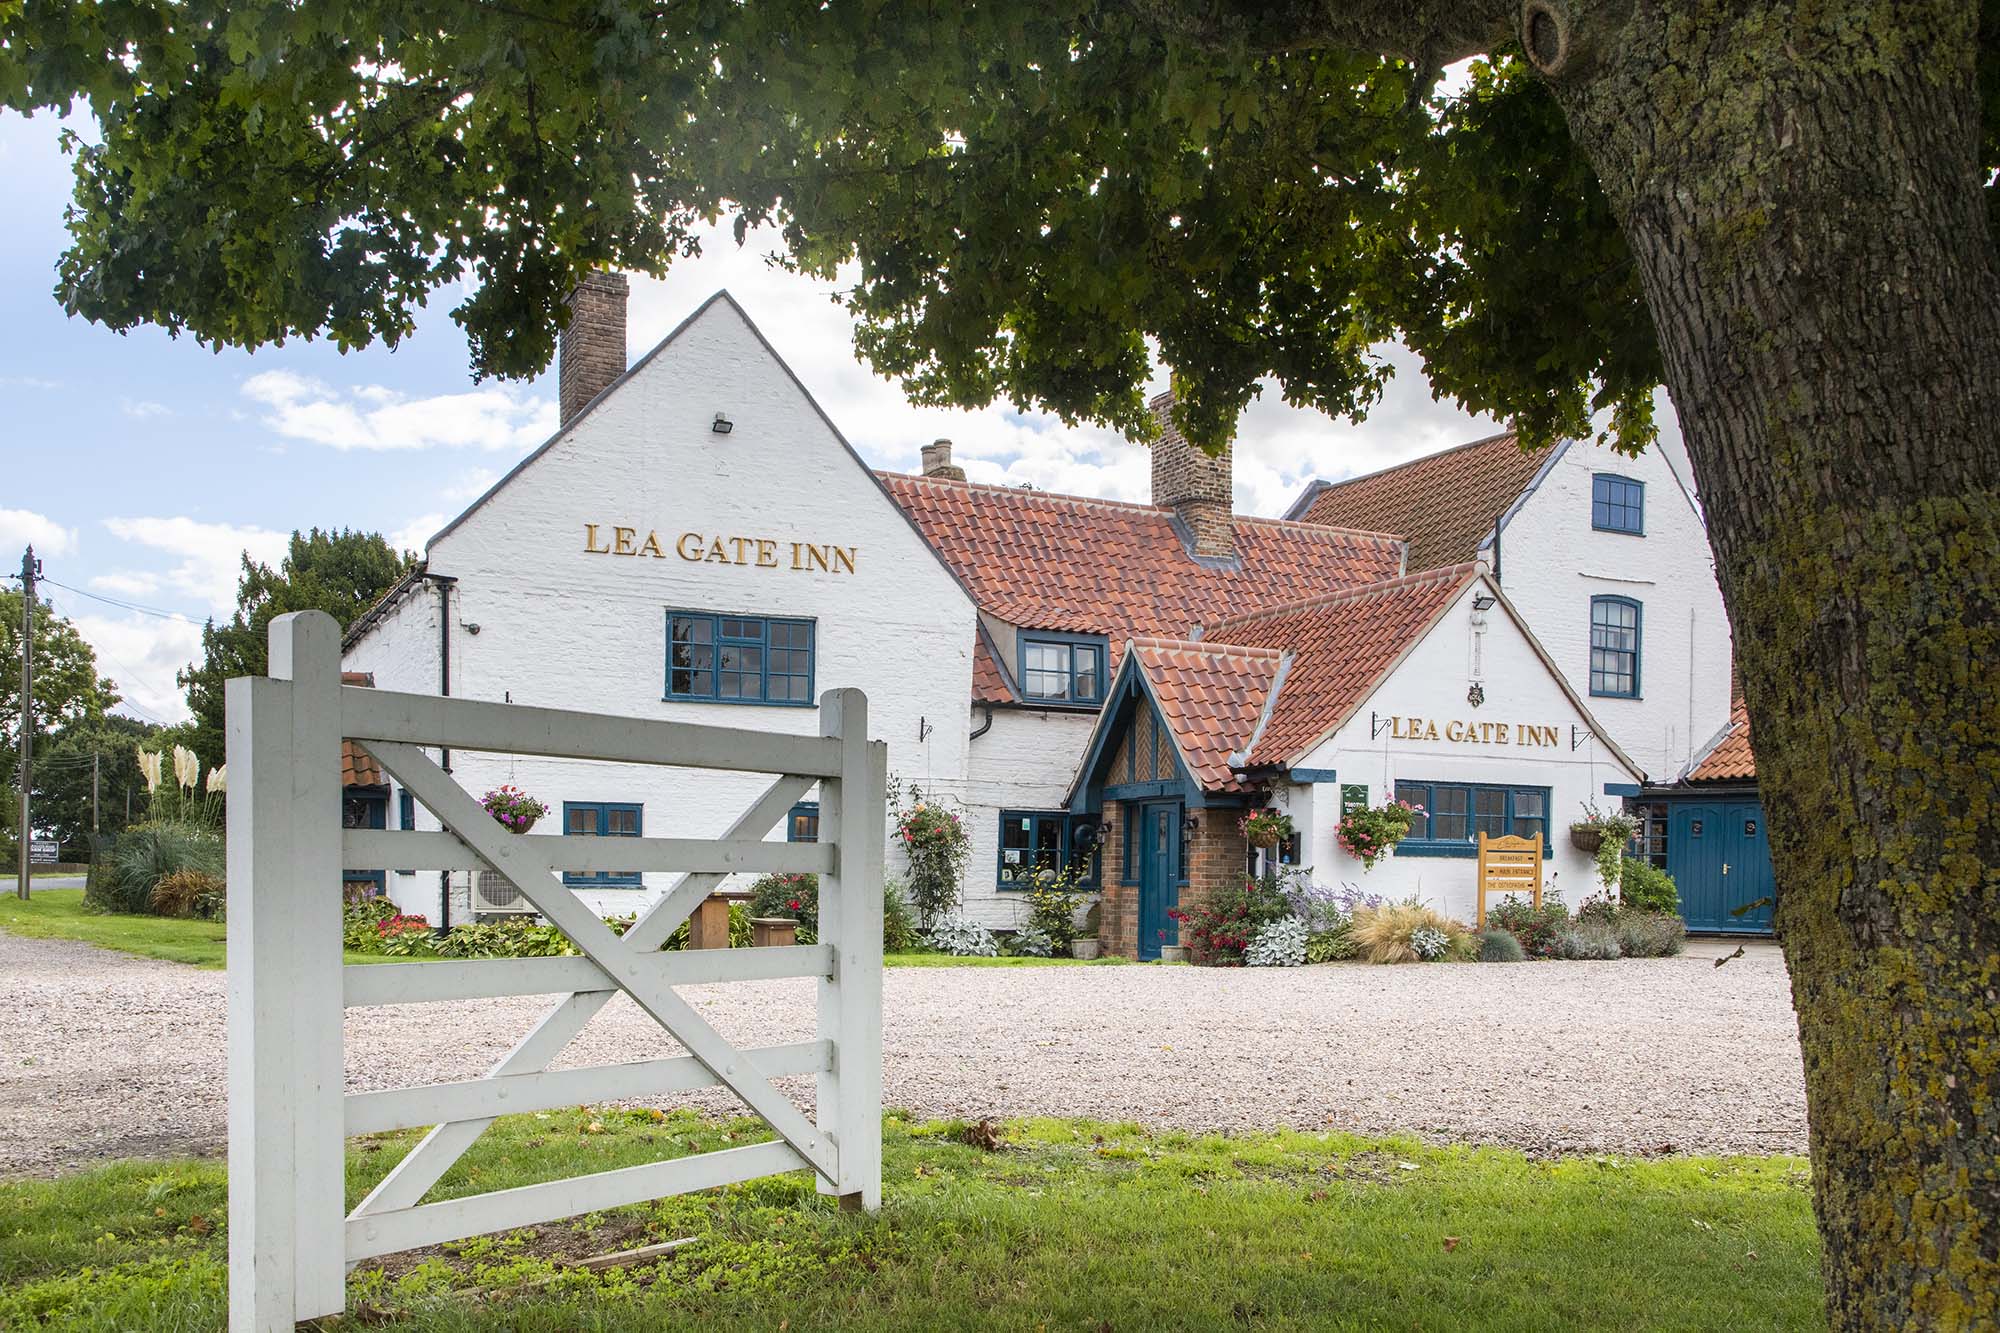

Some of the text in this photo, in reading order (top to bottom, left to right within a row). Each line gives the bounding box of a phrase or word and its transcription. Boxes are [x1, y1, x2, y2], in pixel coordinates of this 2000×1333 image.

[584, 523, 858, 575] LEA GATE INN
[1391, 716, 1559, 748] LEA GATE INN
